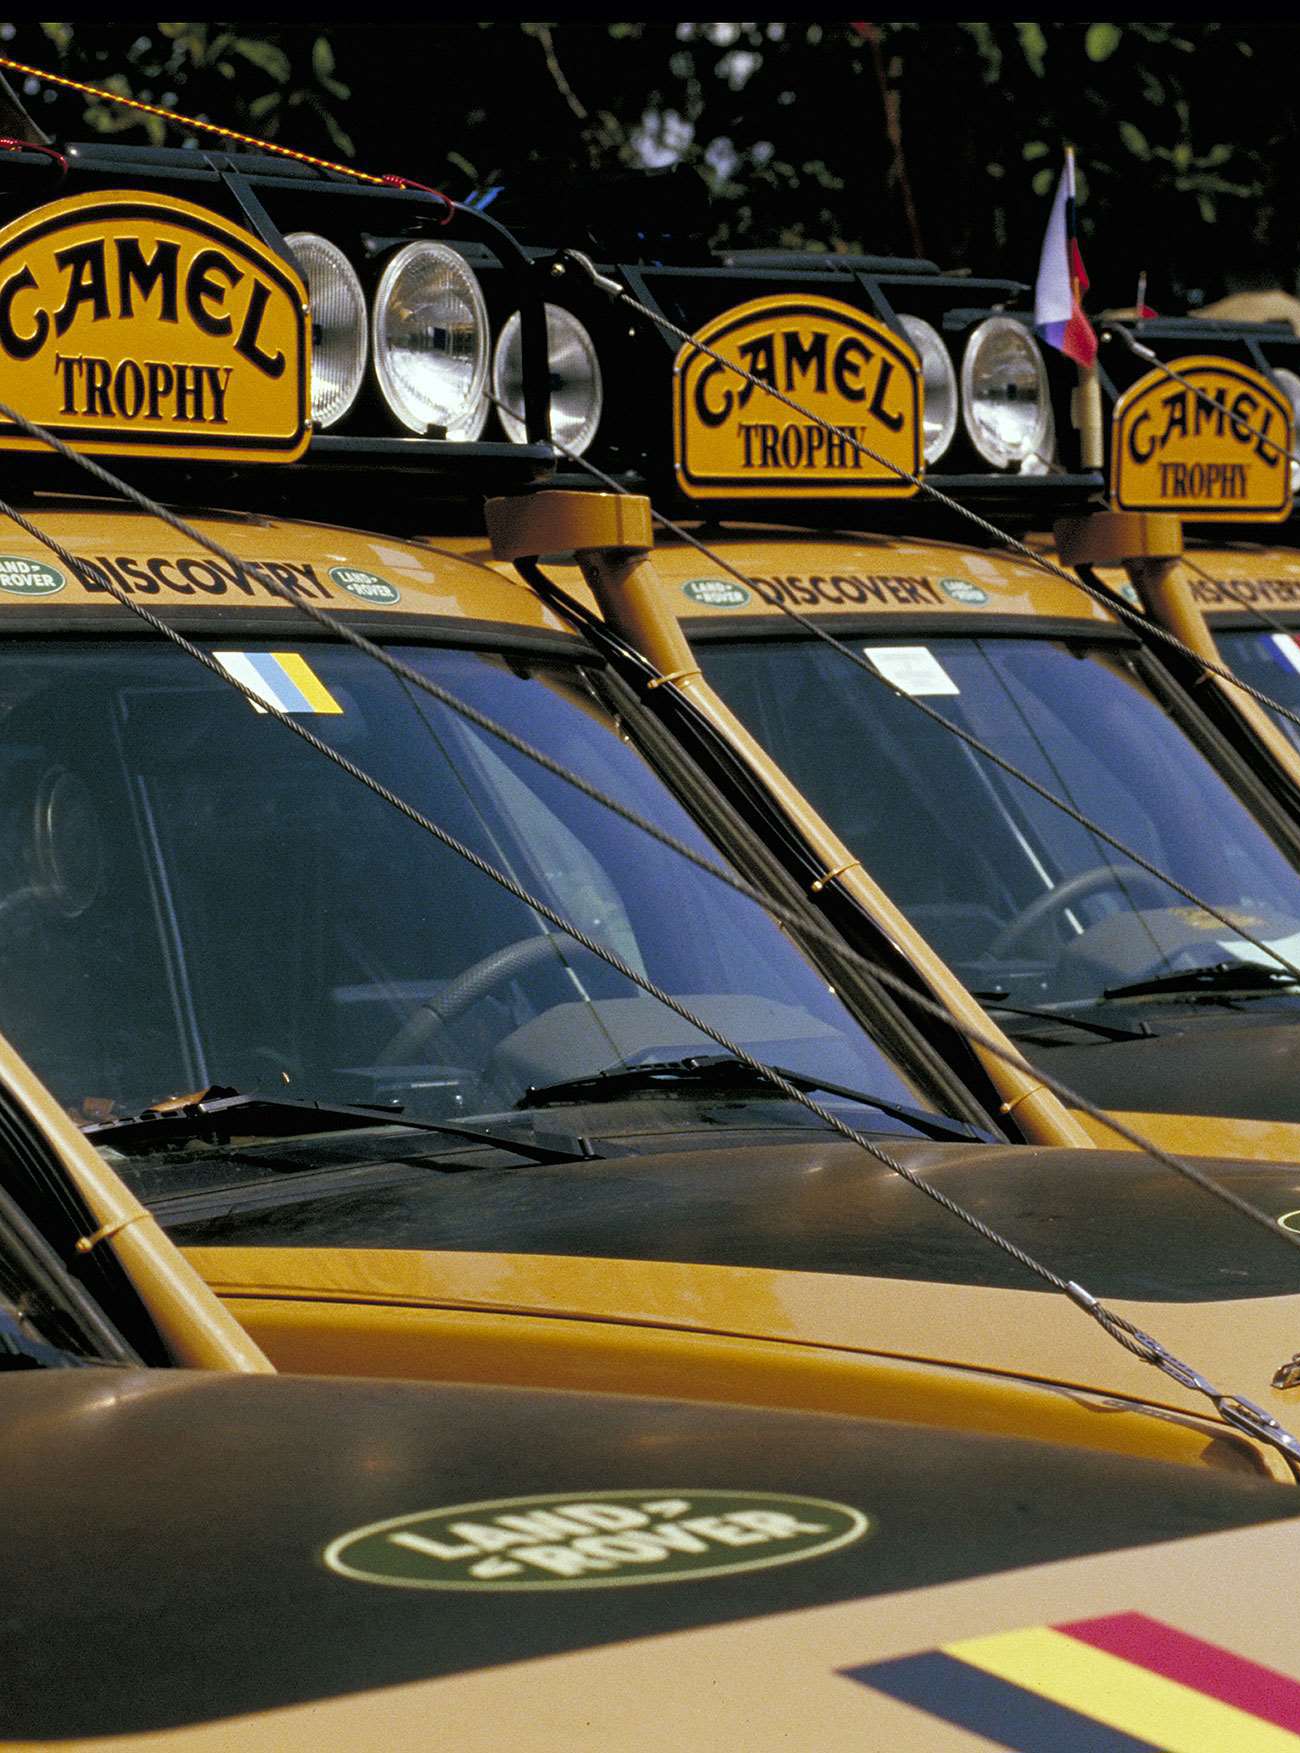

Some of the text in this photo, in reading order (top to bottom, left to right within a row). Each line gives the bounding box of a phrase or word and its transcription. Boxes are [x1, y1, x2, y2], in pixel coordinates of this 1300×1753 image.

[0, 237, 286, 380] CAMEL
[55, 352, 233, 425] TROPHY
[694, 330, 905, 433] CAMEL
[737, 422, 868, 469] TROPHY
[1128, 386, 1280, 467] CAMEL
[1157, 461, 1249, 499] TROPHY
[0, 560, 31, 574] AND
[0, 573, 57, 587] ROVER
[57, 555, 335, 600] DISCOVERY
[336, 570, 372, 585] LAND
[744, 575, 944, 605] DISCOVERY
[388, 1501, 652, 1561] LAND
[506, 1509, 832, 1578] ROVER
